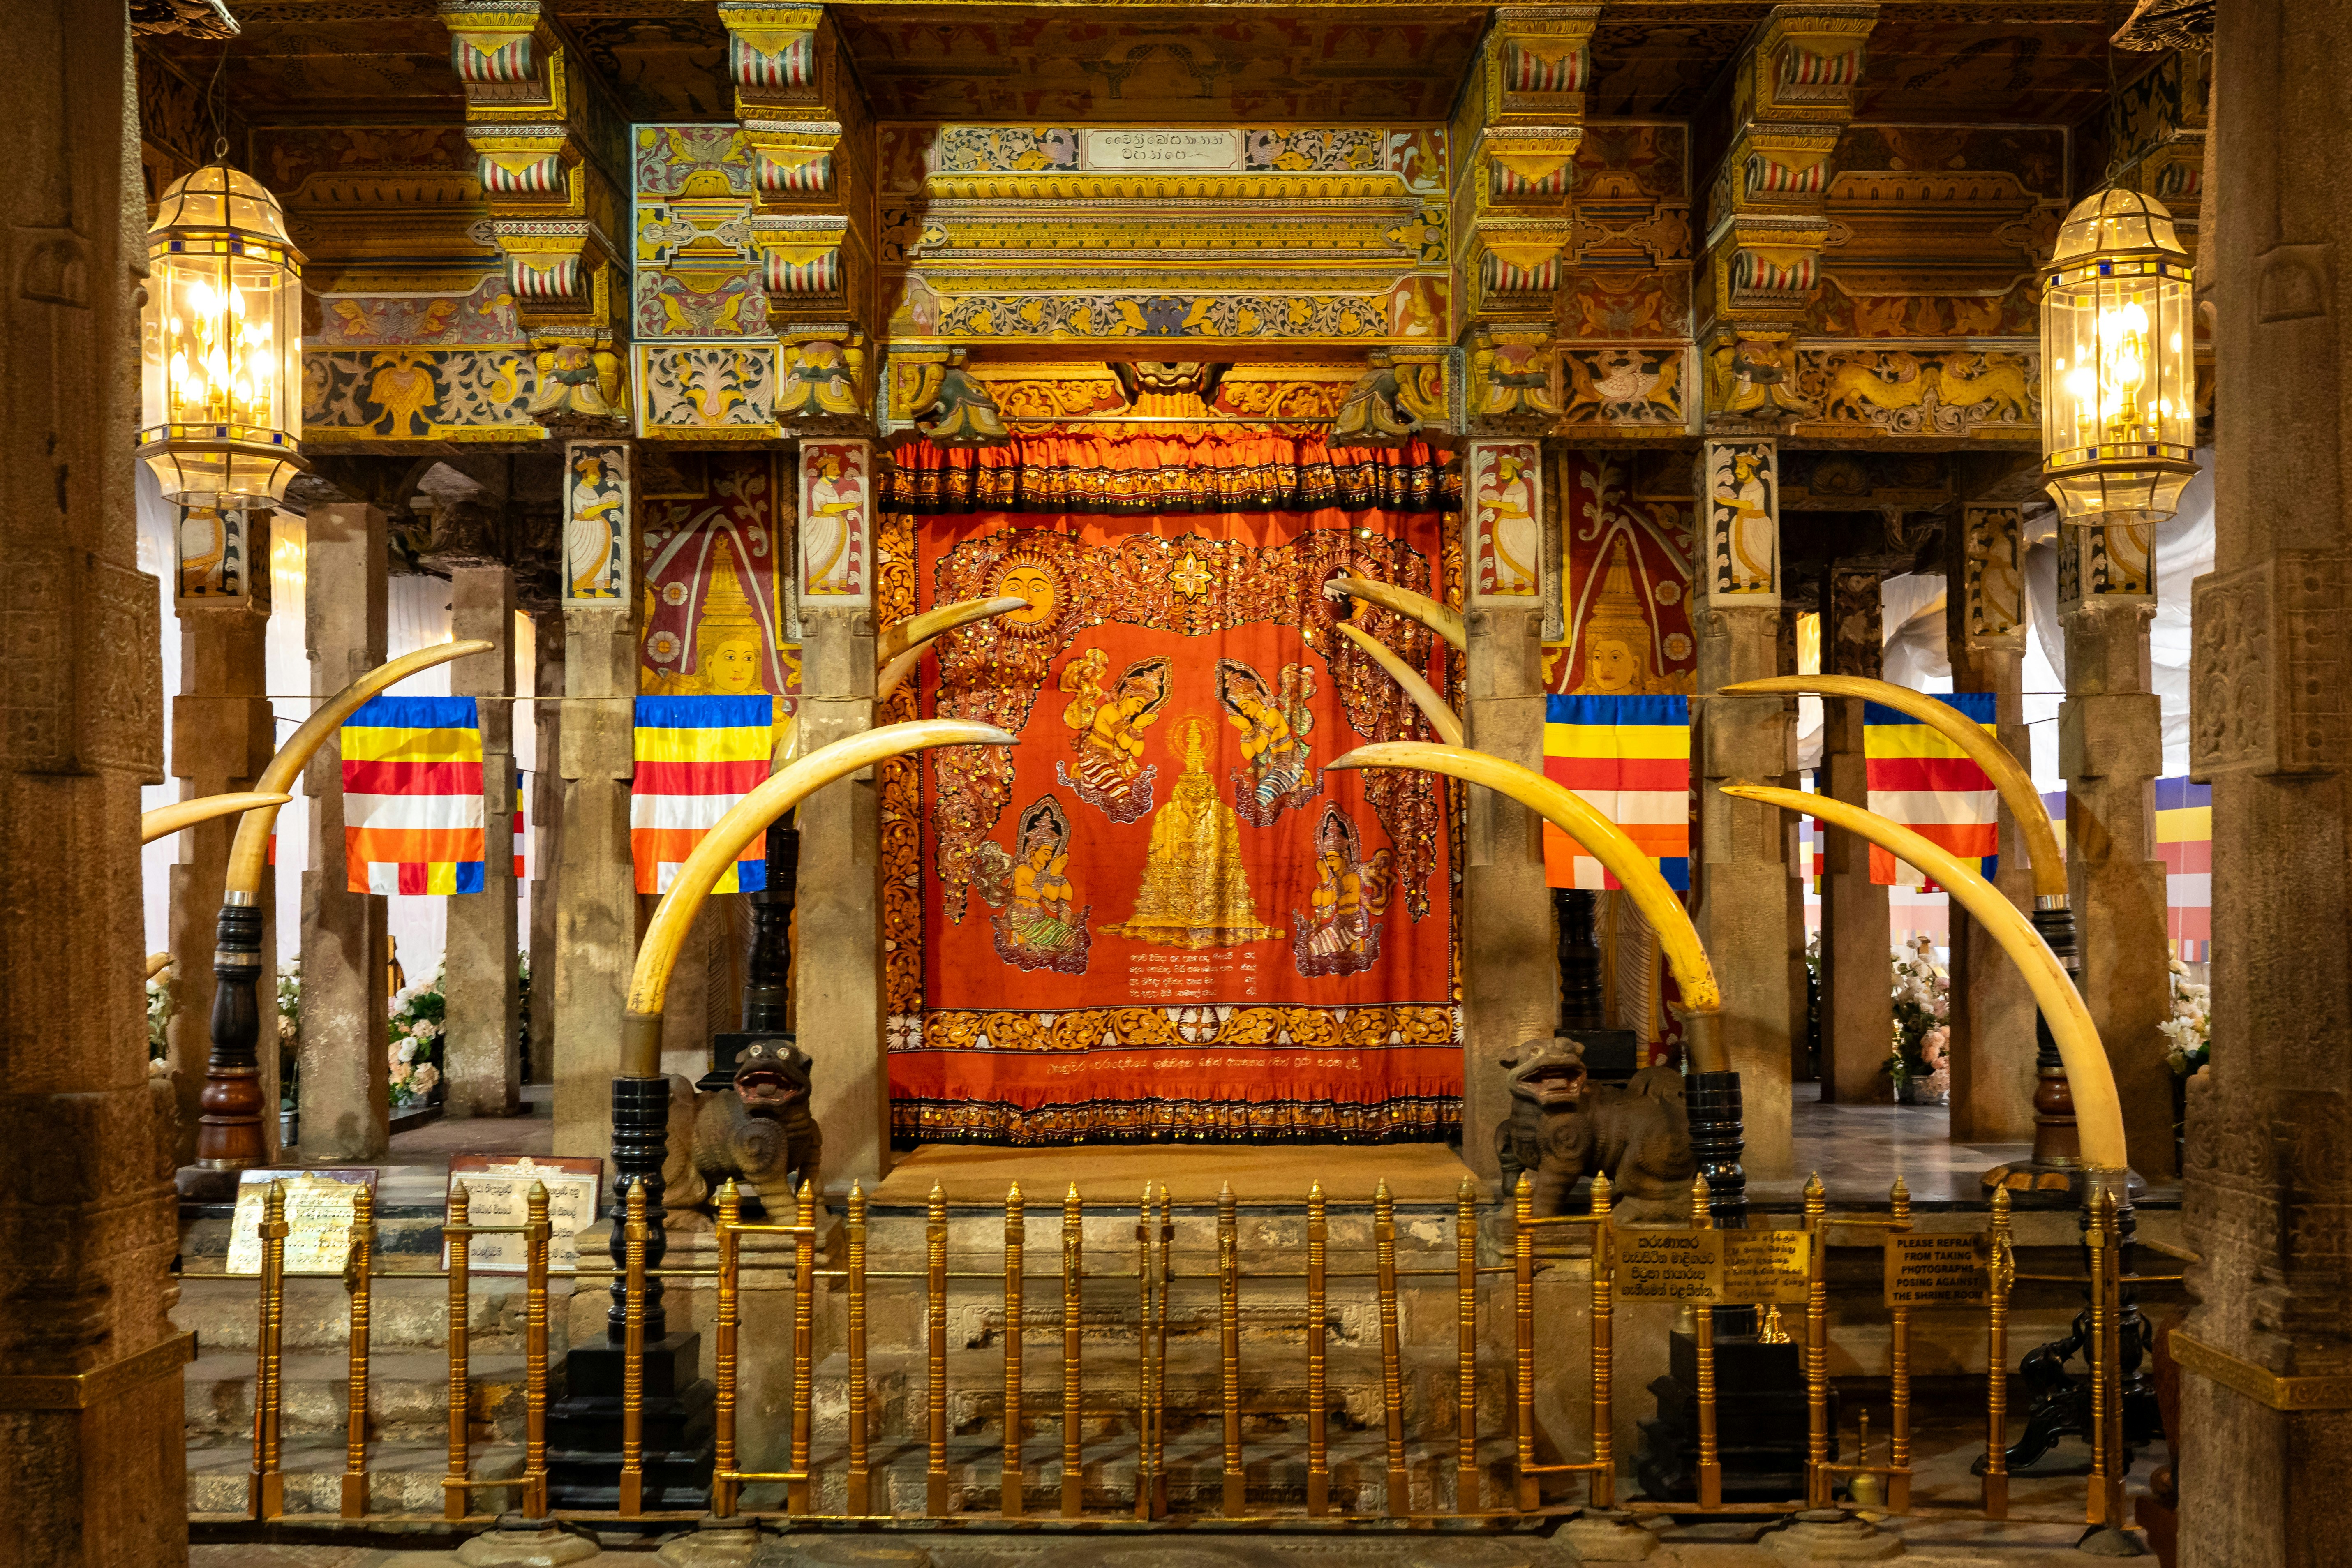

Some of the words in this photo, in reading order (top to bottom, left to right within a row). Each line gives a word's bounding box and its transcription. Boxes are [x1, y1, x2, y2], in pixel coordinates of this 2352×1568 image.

[1638, 1235, 1699, 1249] කරුණාකර
[1897, 1239, 1934, 1248] PLEASE
[1936, 1238, 1978, 1247] REFRAIN
[1904, 1252, 1932, 1261] FROM
[1934, 1252, 1972, 1261] TAKING
[1901, 1265, 1975, 1274] PHOTOGRAPHS
[1897, 1278, 1933, 1287] POSING
[1936, 1278, 1980, 1287] AGAINST
[1892, 1292, 1911, 1300] THE
[1914, 1291, 1951, 1300] SHRINE
[1953, 1291, 1983, 1300] ROOM
